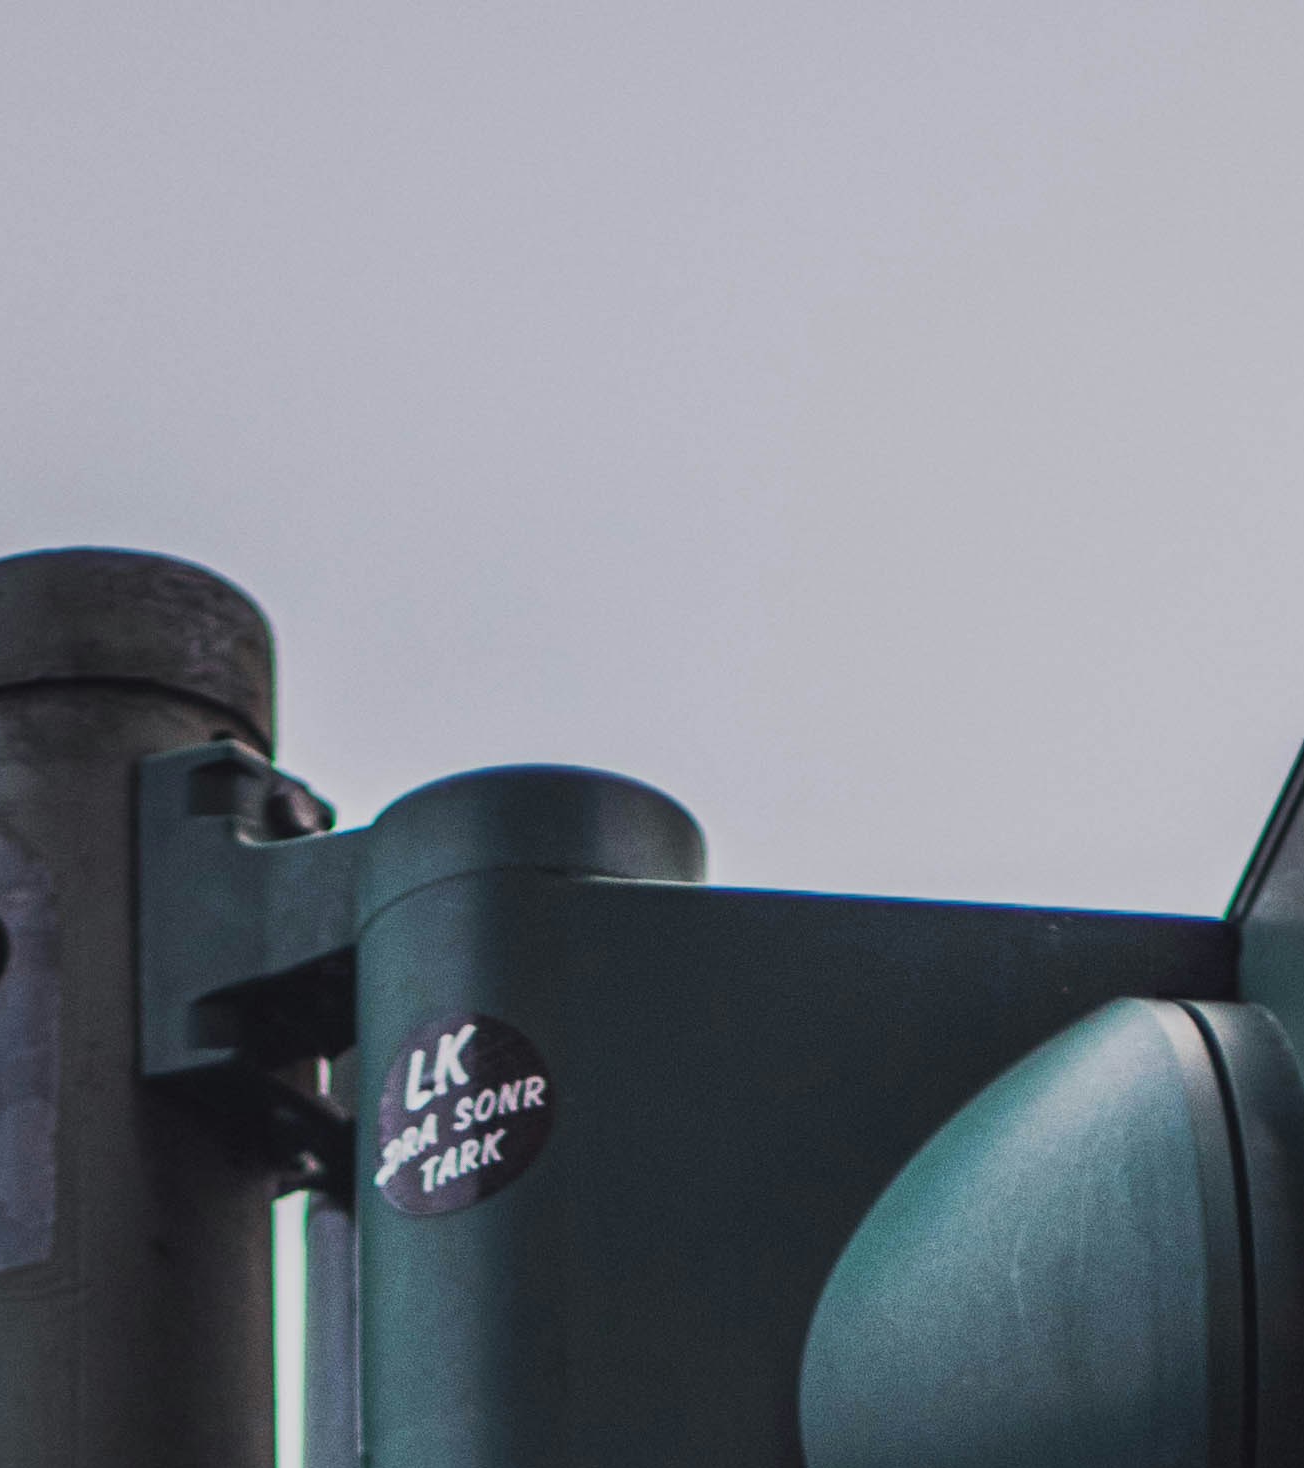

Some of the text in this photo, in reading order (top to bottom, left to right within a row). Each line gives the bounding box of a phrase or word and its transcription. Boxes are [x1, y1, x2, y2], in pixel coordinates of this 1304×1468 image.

[406, 1023, 476, 1113] LK
[453, 1076, 546, 1132] SONR
[419, 1128, 506, 1193] TARK
